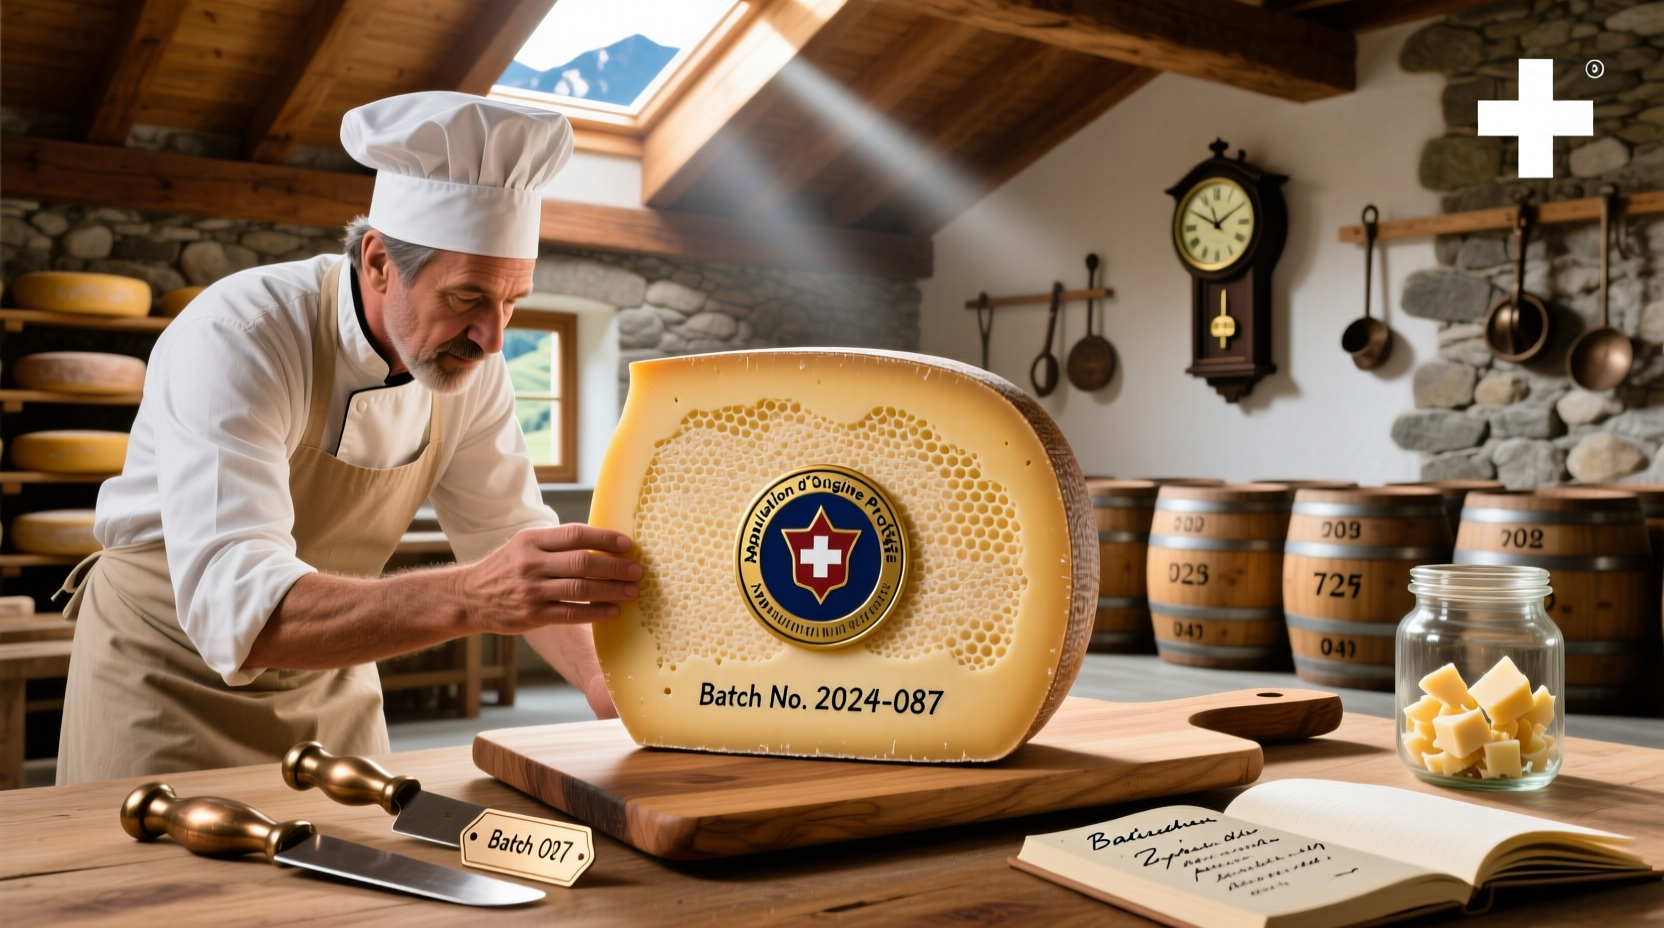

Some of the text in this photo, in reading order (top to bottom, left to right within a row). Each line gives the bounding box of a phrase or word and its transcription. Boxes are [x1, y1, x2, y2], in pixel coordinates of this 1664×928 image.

[699, 682, 945, 715] Batch No. 2024-087
[487, 828, 534, 856] Batch
